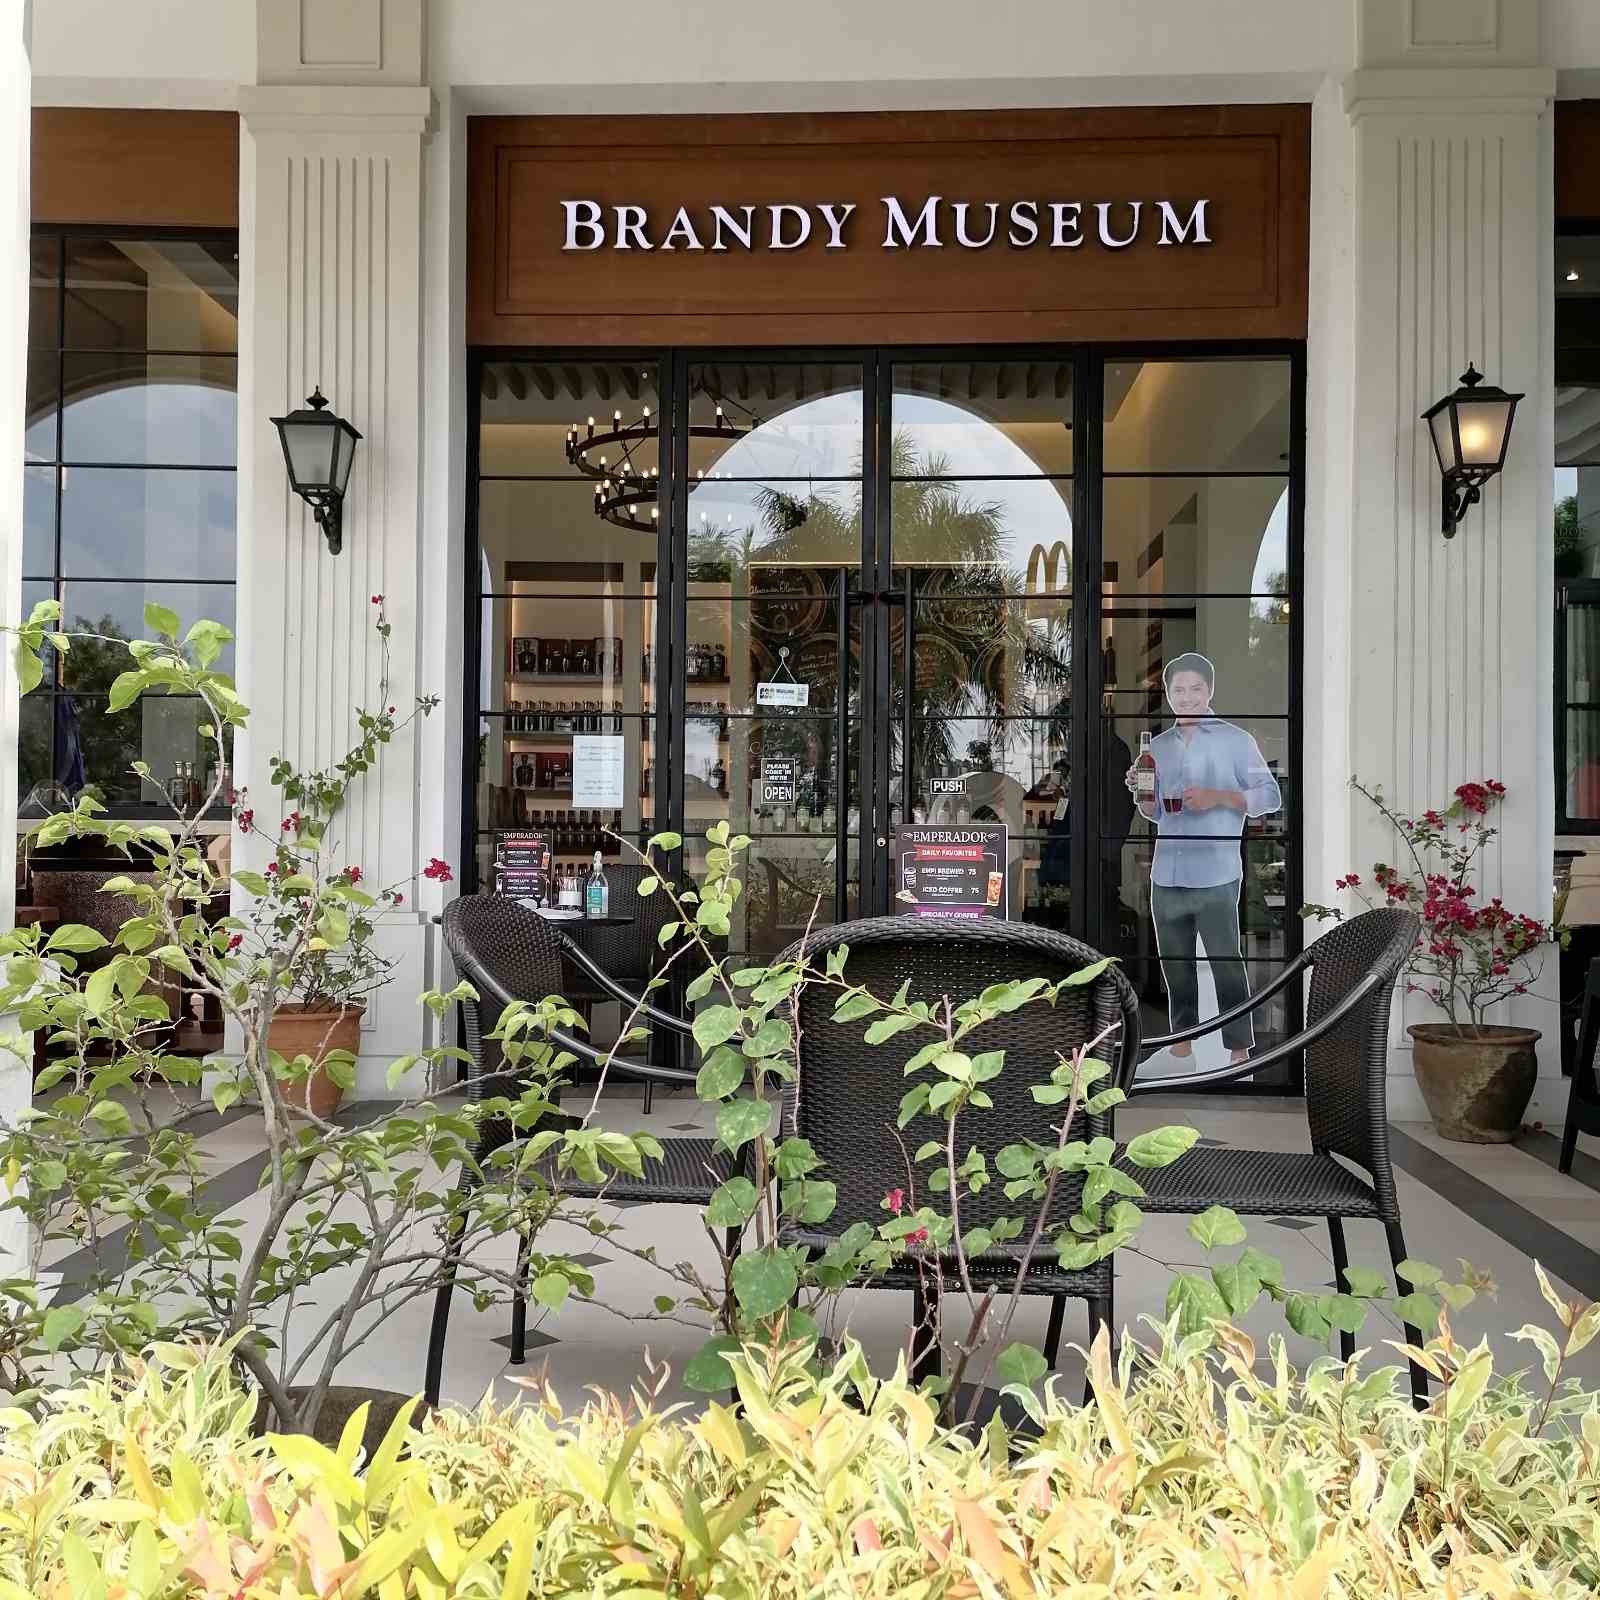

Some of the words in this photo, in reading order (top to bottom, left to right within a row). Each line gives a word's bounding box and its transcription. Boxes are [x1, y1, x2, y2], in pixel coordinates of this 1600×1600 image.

[561, 198, 857, 251] BRANDY
[881, 195, 1213, 250] MUSEUM
[933, 780, 963, 792] PUSH
[764, 786, 792, 801] OPEN
[912, 831, 989, 843] EMPERADOR
[941, 849, 977, 857] FAVORITES
[967, 868, 977, 876] 75
[920, 911, 953, 919] SPECIALTY
[953, 911, 979, 919] COFFEE
